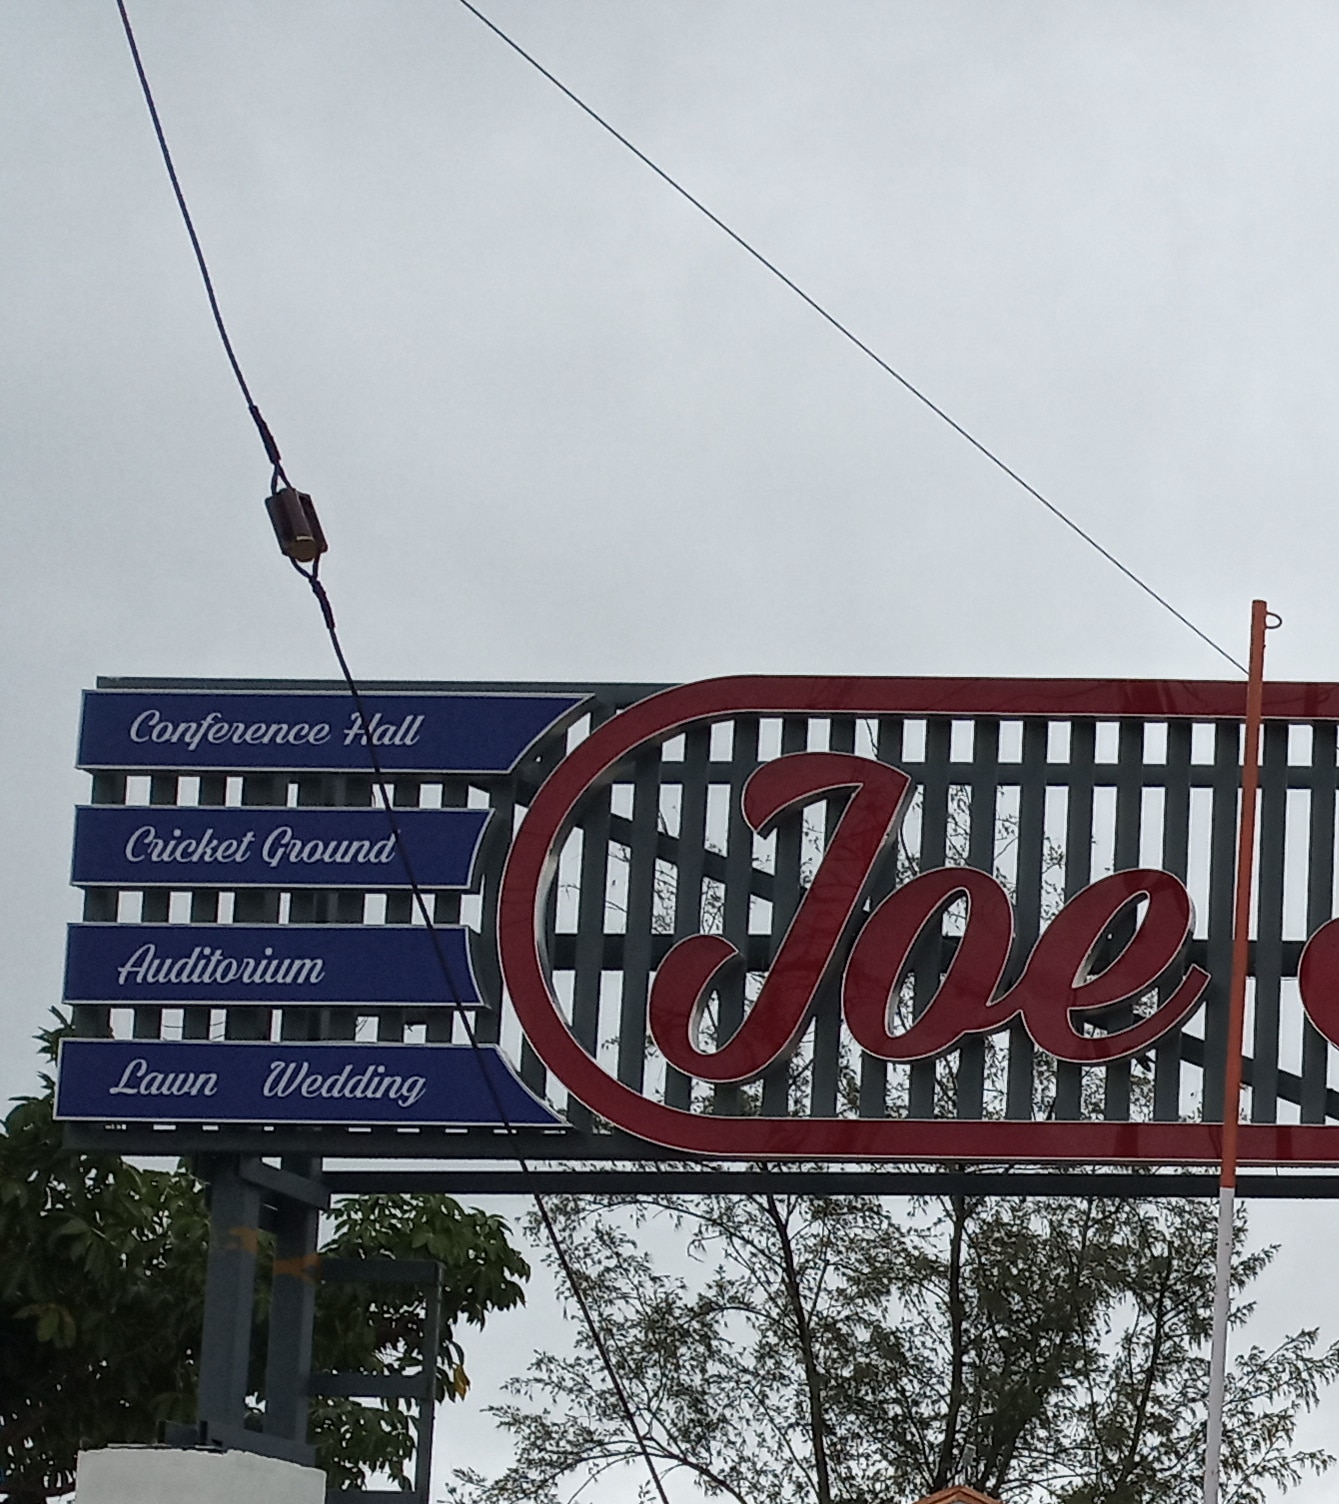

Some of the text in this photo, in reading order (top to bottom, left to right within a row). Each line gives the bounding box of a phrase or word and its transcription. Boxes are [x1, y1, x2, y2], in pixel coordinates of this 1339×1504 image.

[130, 710, 425, 751] Conference Hall
[125, 826, 397, 867] Cricket Ground
[648, 750, 1212, 1084] Joe
[117, 943, 327, 985] Auditorium
[109, 1059, 427, 1107] Lawn Wedding
